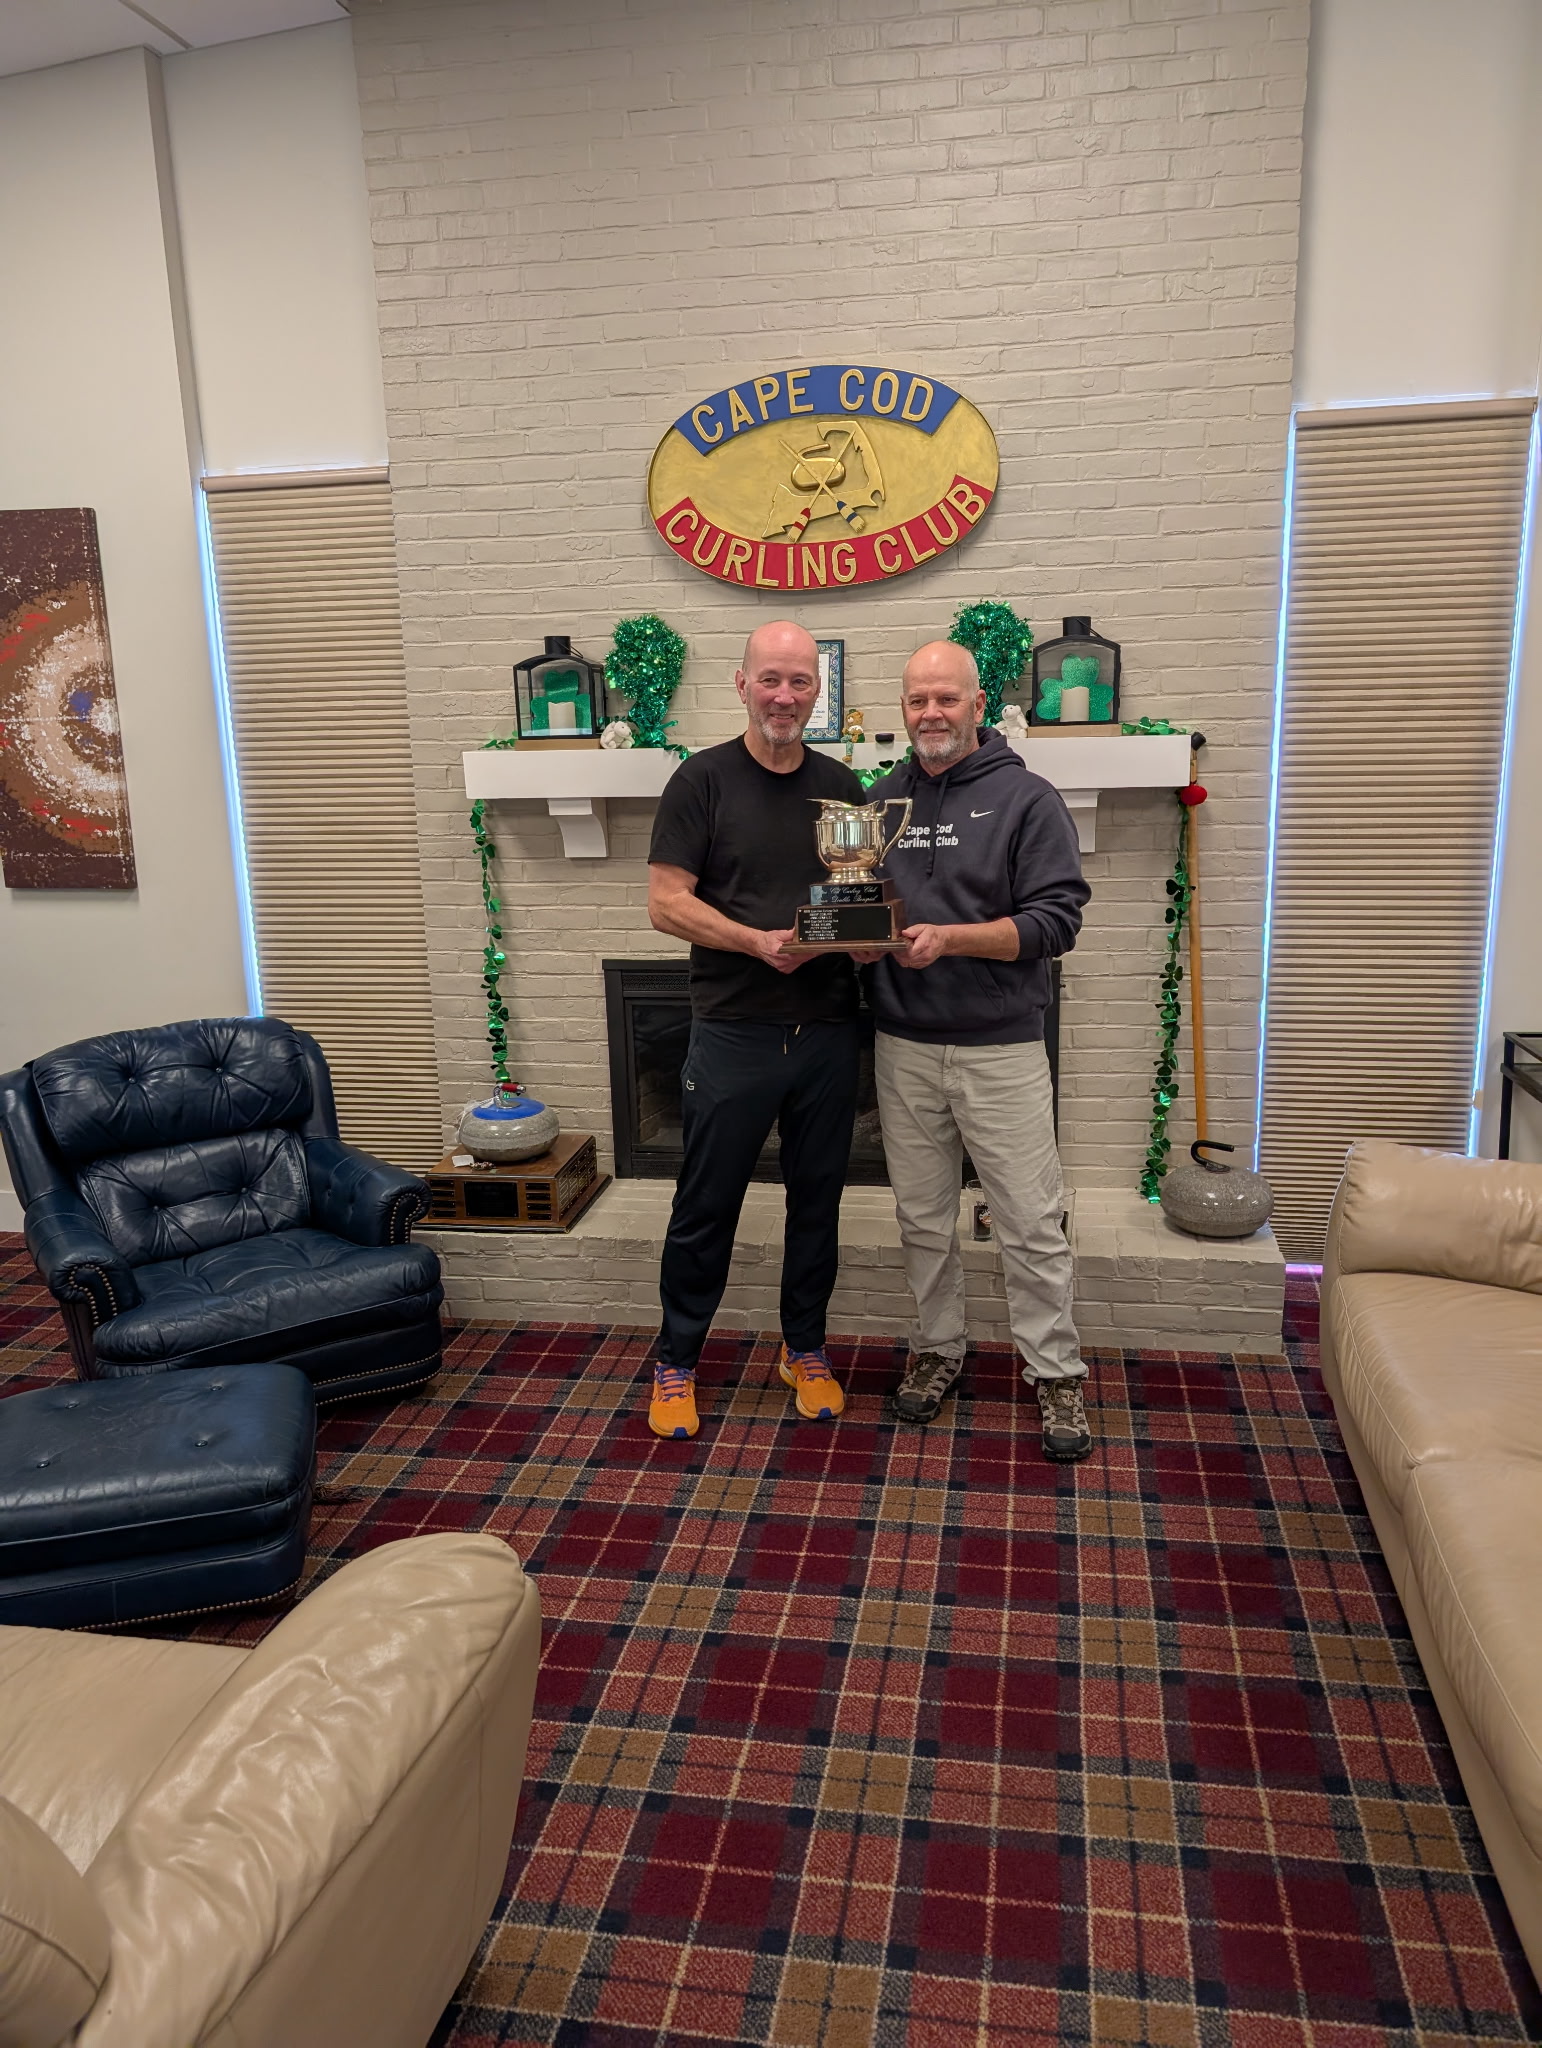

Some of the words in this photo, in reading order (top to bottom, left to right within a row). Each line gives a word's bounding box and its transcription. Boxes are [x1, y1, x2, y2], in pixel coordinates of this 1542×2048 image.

[691, 369, 814, 443] CAPE
[840, 369, 934, 422] COD
[665, 509, 857, 587] CURLING
[873, 483, 986, 573] CLUB
[906, 826, 930, 837] Cape
[935, 836, 959, 847] Club
